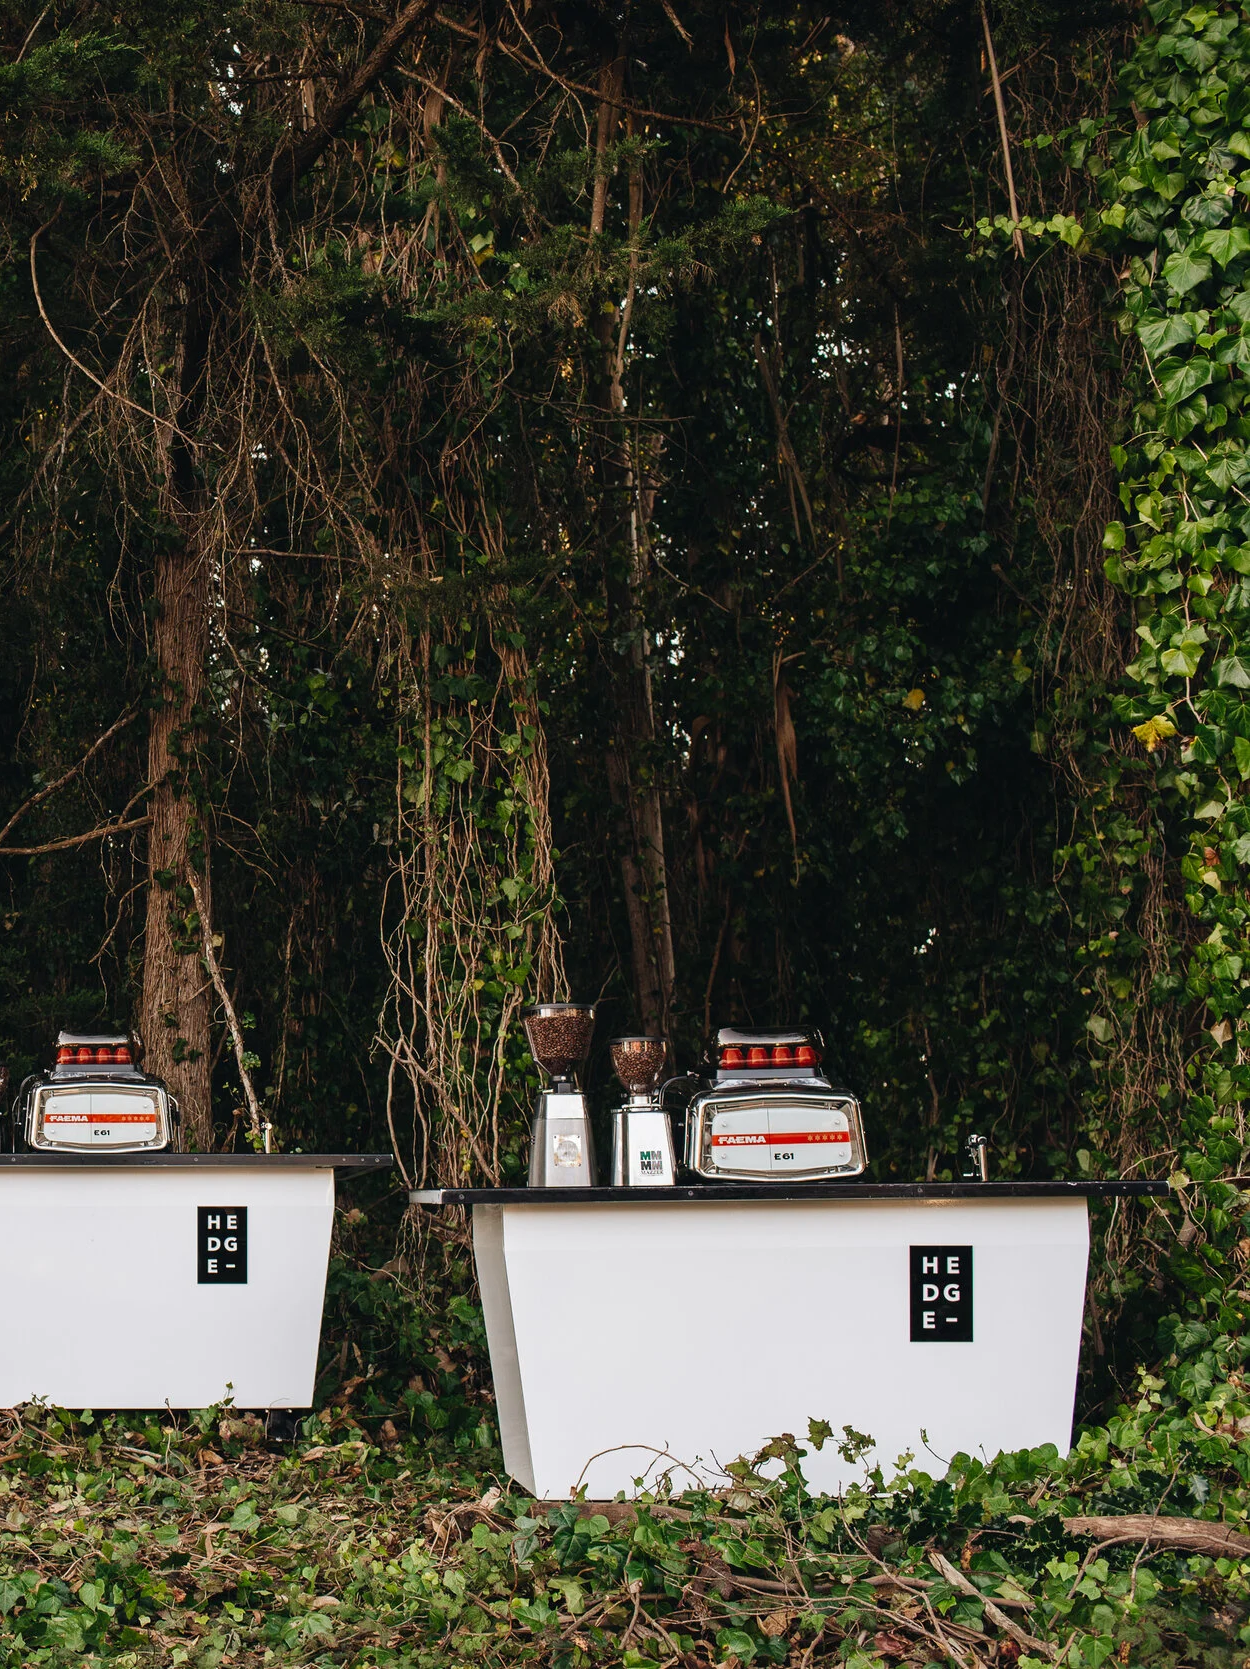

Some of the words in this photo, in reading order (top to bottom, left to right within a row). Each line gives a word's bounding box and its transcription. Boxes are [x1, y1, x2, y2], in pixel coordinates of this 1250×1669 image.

[717, 1135, 767, 1144] FAEMA
[639, 1150, 662, 1160] MM
[640, 1160, 663, 1170] MM
